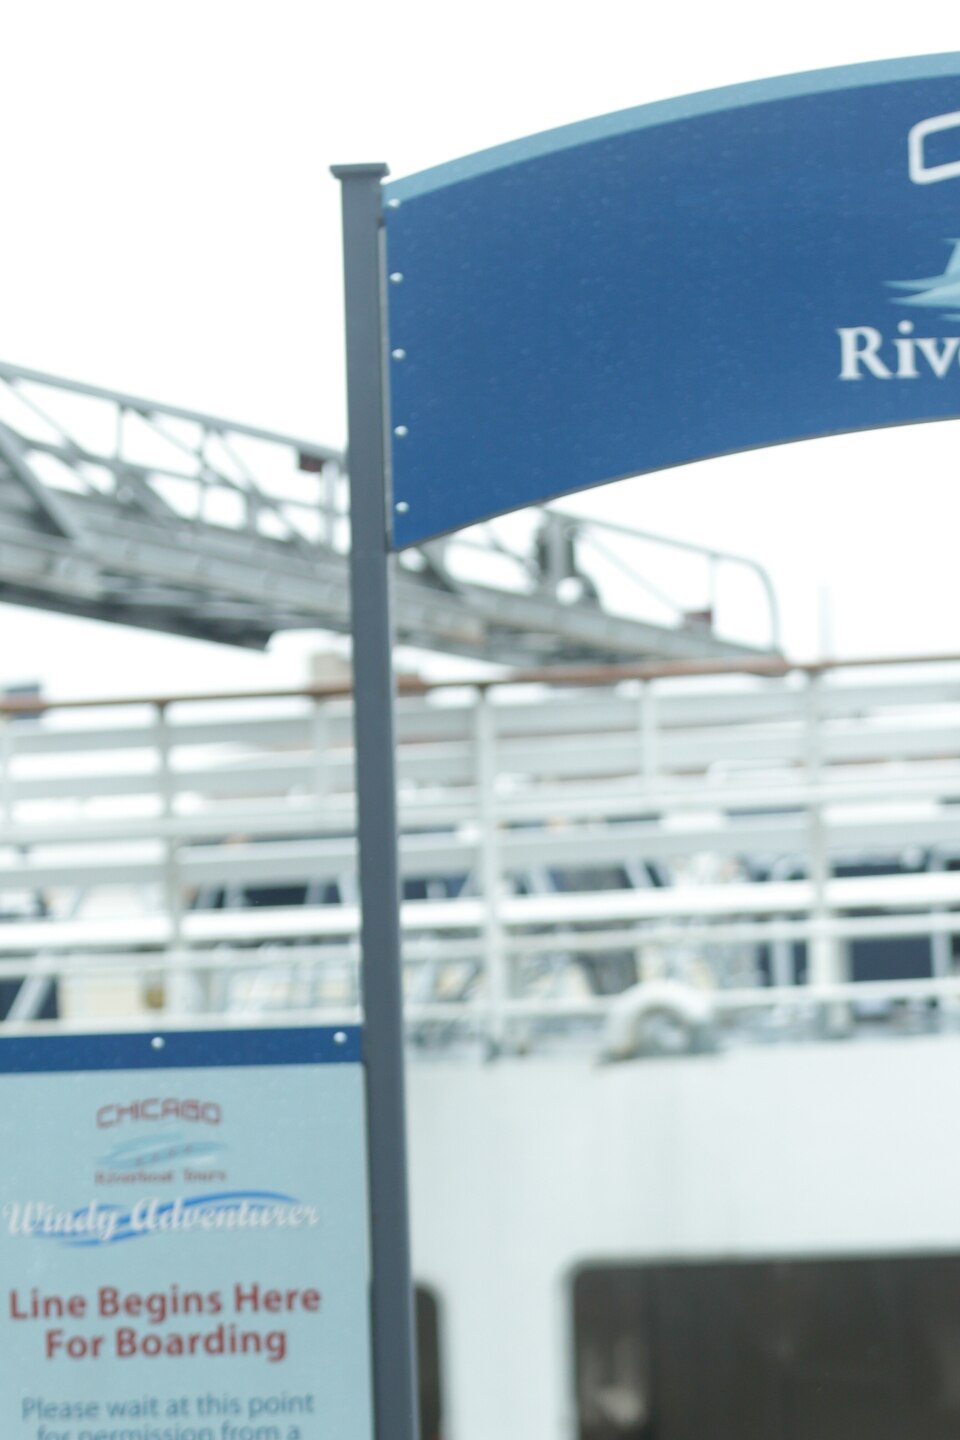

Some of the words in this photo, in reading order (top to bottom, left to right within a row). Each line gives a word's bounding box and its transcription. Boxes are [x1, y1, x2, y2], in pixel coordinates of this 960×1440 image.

[96, 1097, 222, 1130] CHICAGO
[3, 1199, 120, 1241] Windy
[131, 1197, 320, 1231] Adventurer
[10, 1288, 87, 1321] Line
[98, 1283, 223, 1324] Begins
[234, 1282, 321, 1314] Here
[45, 1328, 105, 1360] For
[115, 1323, 288, 1363] Boarding
[21, 1396, 99, 1422] Please
[106, 1394, 159, 1419] wait
[165, 1397, 190, 1417] at
[196, 1392, 242, 1416] this
[248, 1391, 314, 1420] point
